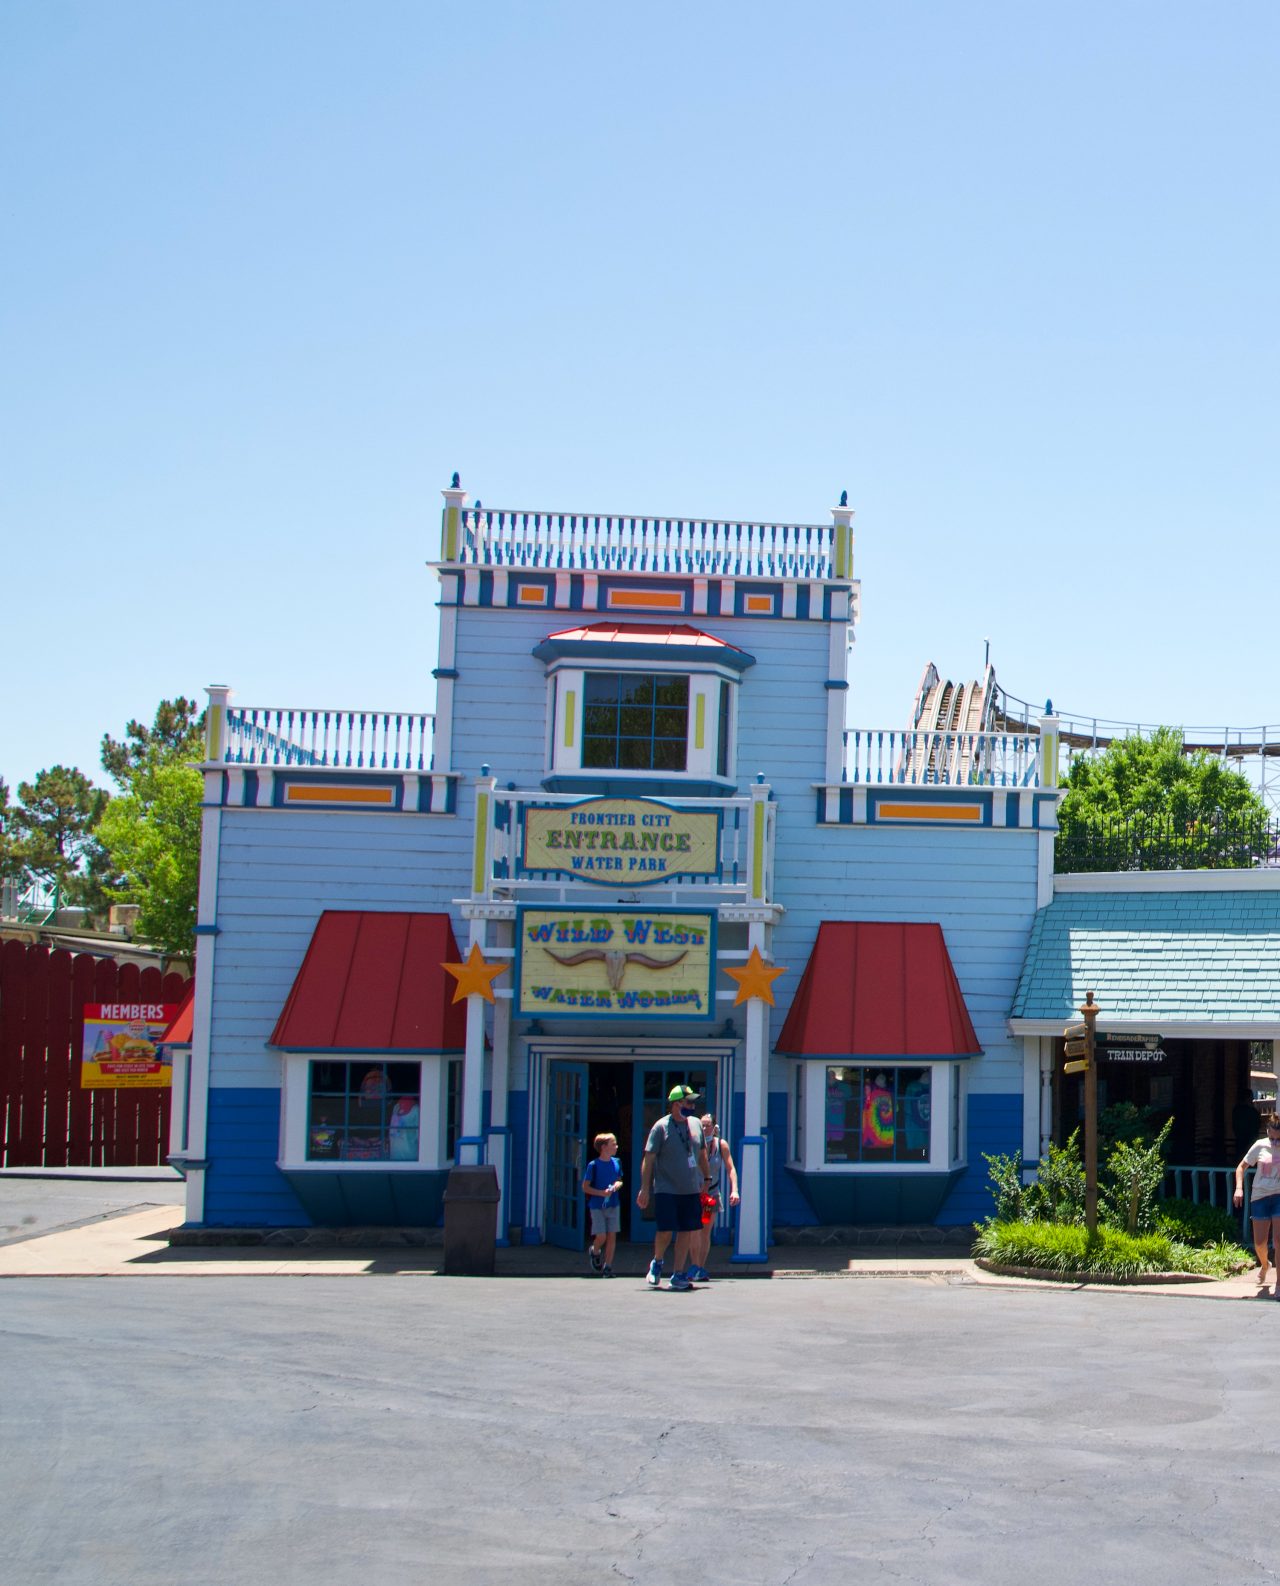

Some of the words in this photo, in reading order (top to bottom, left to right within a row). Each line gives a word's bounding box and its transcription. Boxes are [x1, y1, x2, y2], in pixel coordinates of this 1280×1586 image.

[571, 813, 635, 826] FRONTIER
[641, 813, 672, 827] CITY
[544, 829, 691, 851] ENTRANCE
[571, 857, 623, 870] WATER
[628, 858, 667, 871] PARK
[527, 918, 614, 944] WILD
[622, 919, 708, 945] WEST
[100, 1003, 164, 1019] MEMBERS
[1106, 1050, 1134, 1061] TRAIN
[1135, 1050, 1163, 1062] DEPOT
